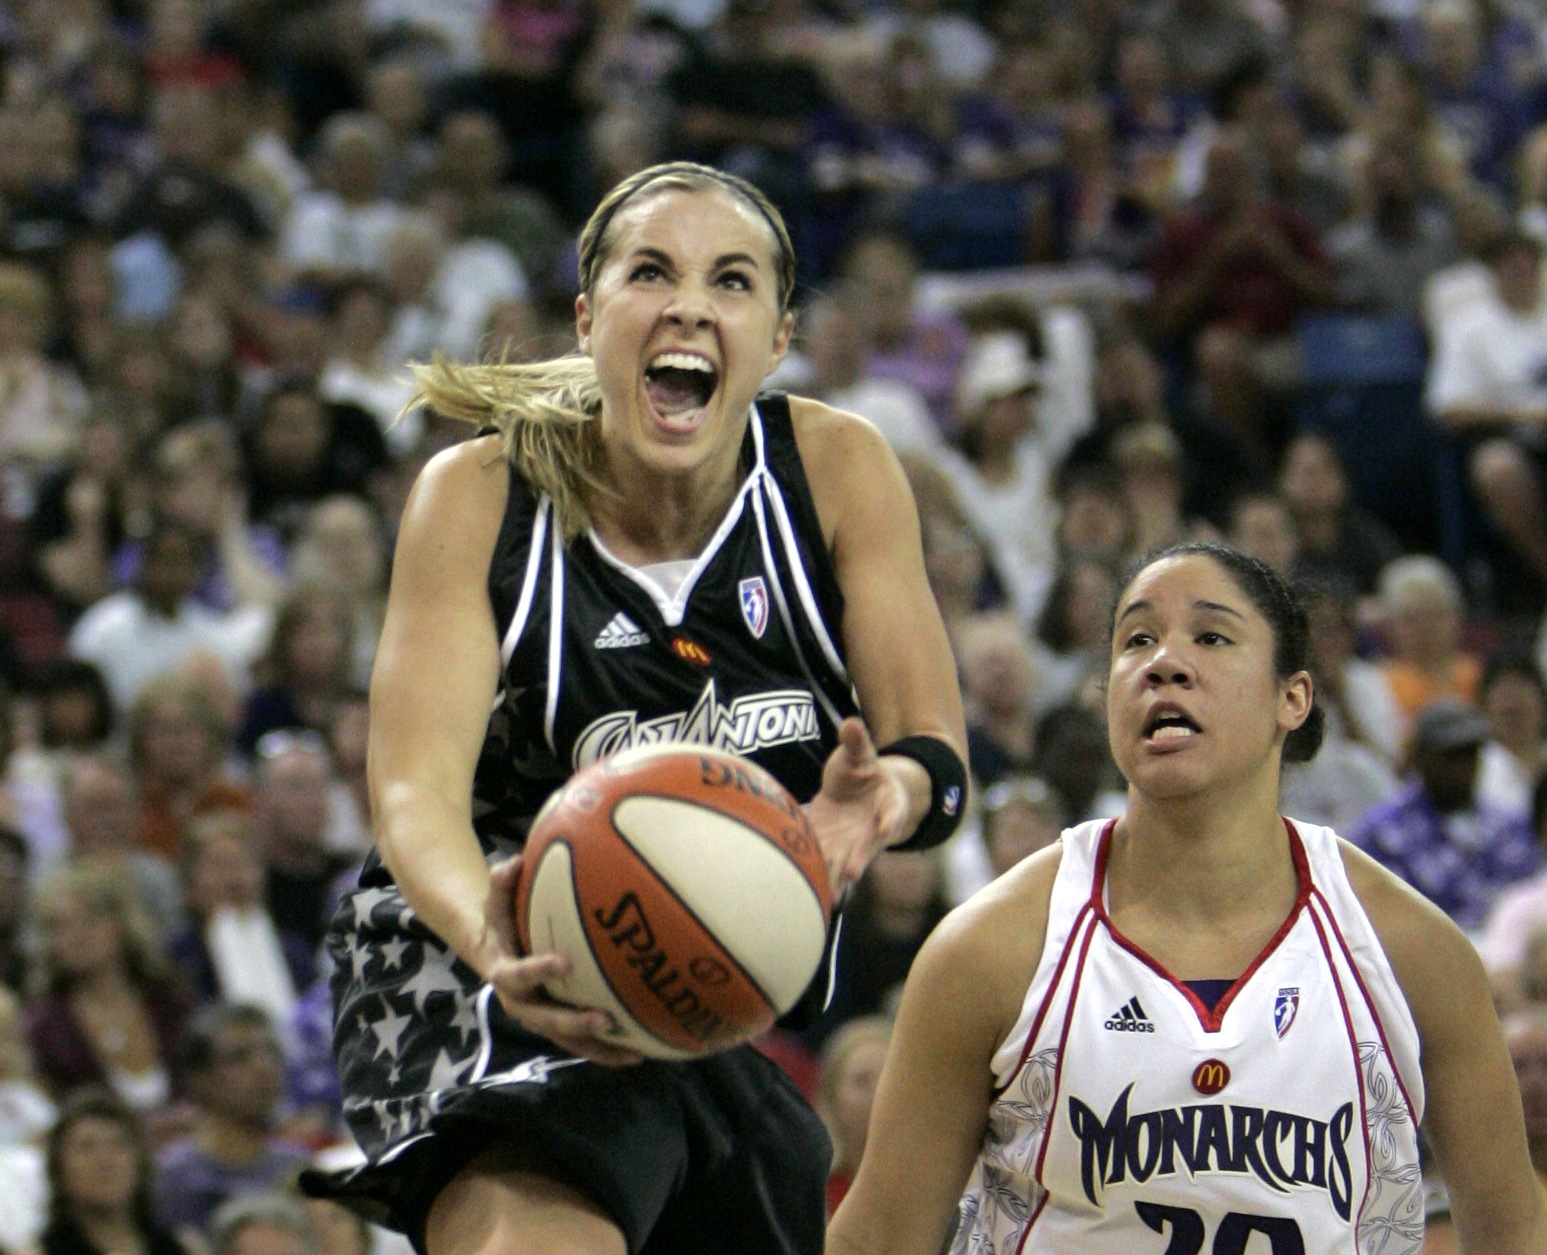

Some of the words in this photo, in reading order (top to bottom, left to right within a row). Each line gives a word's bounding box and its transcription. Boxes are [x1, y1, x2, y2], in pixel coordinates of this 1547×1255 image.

[594, 632, 650, 650] adidas
[683, 678, 821, 755] ANTONI
[1104, 1019, 1155, 1034] adidas
[1068, 1081, 1353, 1223] MONARCHS
